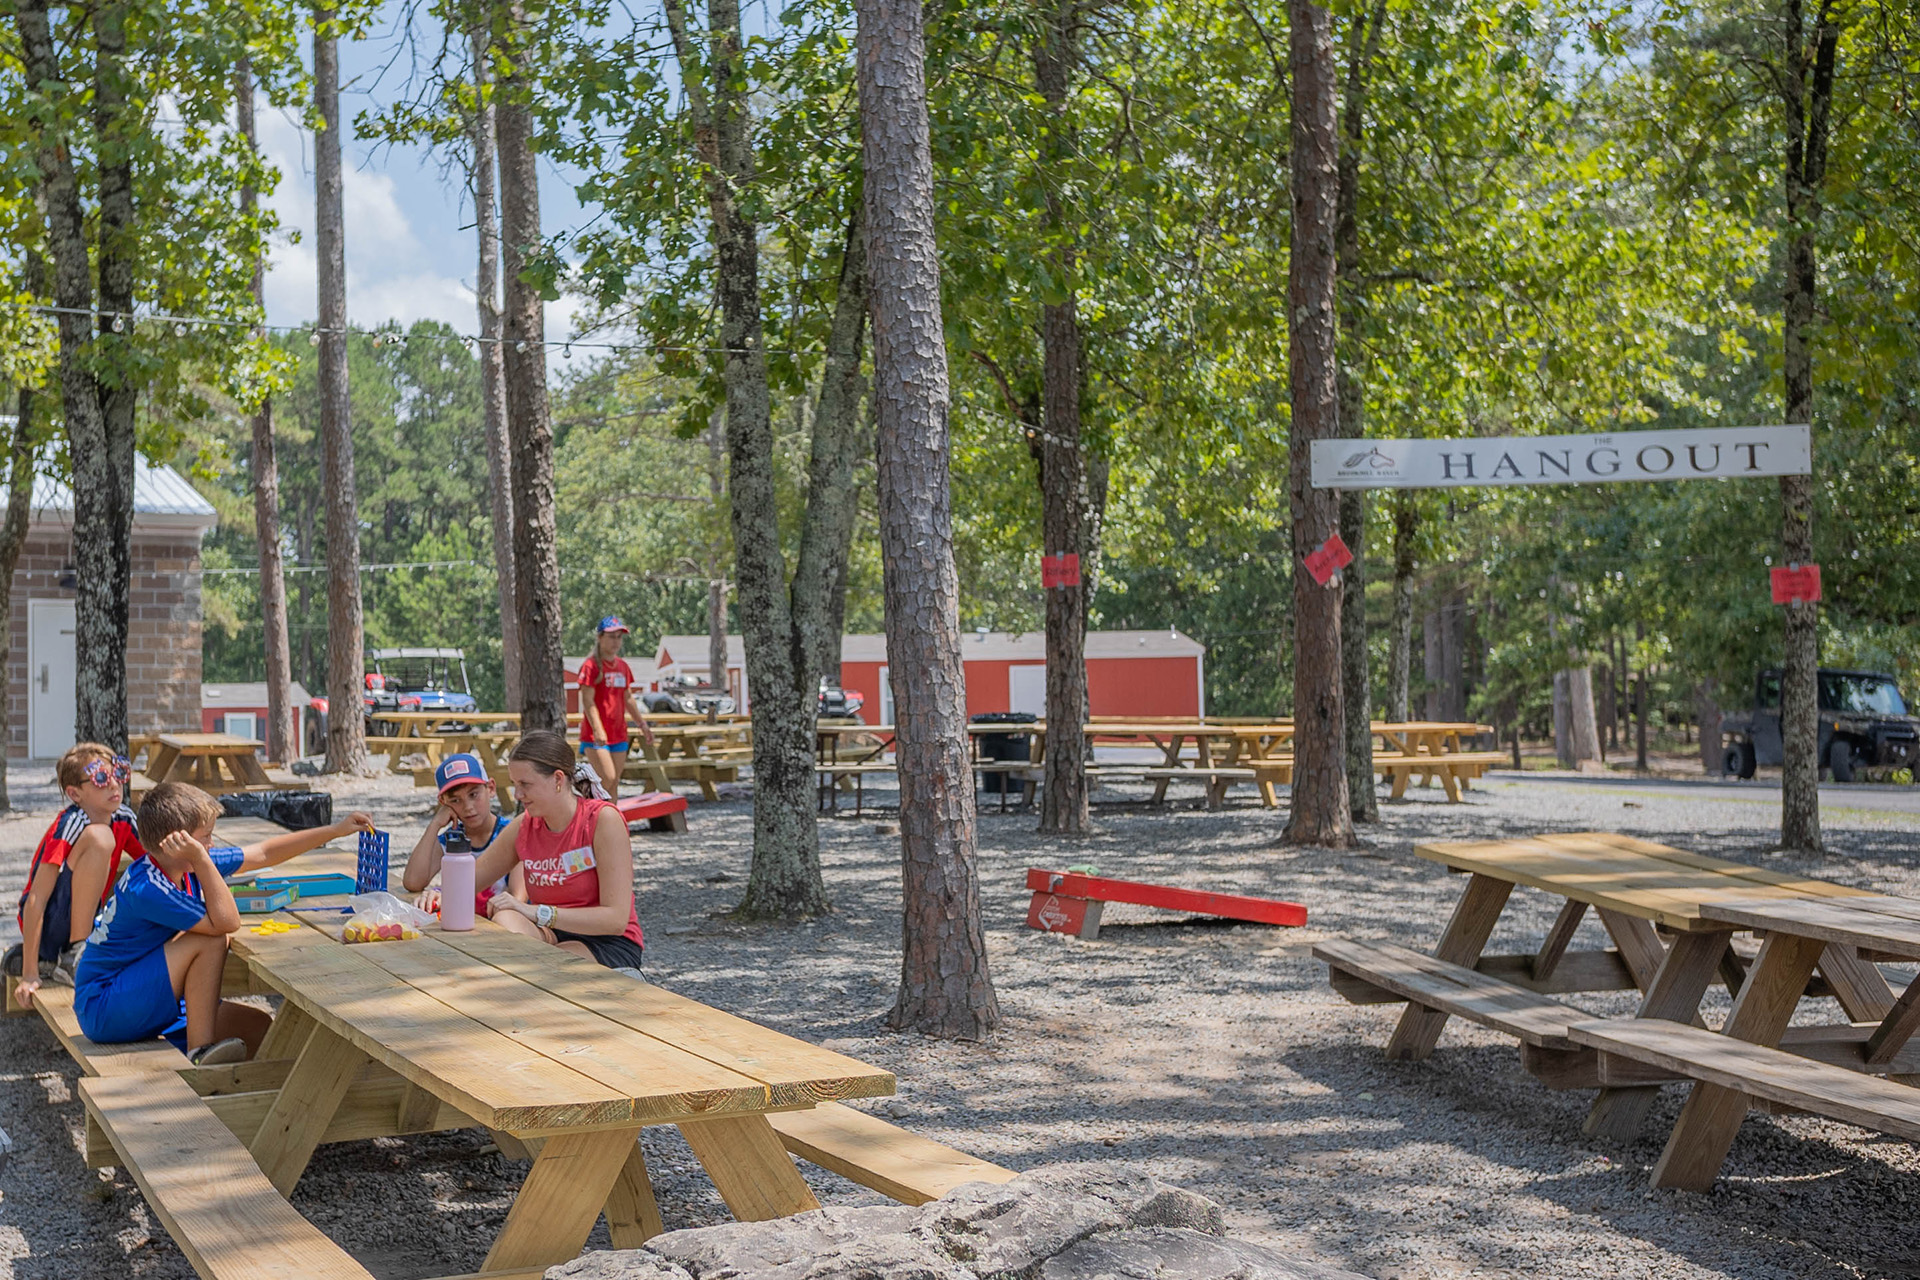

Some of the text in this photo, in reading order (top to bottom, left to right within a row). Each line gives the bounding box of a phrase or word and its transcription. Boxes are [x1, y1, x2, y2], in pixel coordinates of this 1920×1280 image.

[1593, 436, 1612, 445] THE
[1438, 442, 1770, 479] HANGOUT
[528, 871, 567, 886] STAFF
